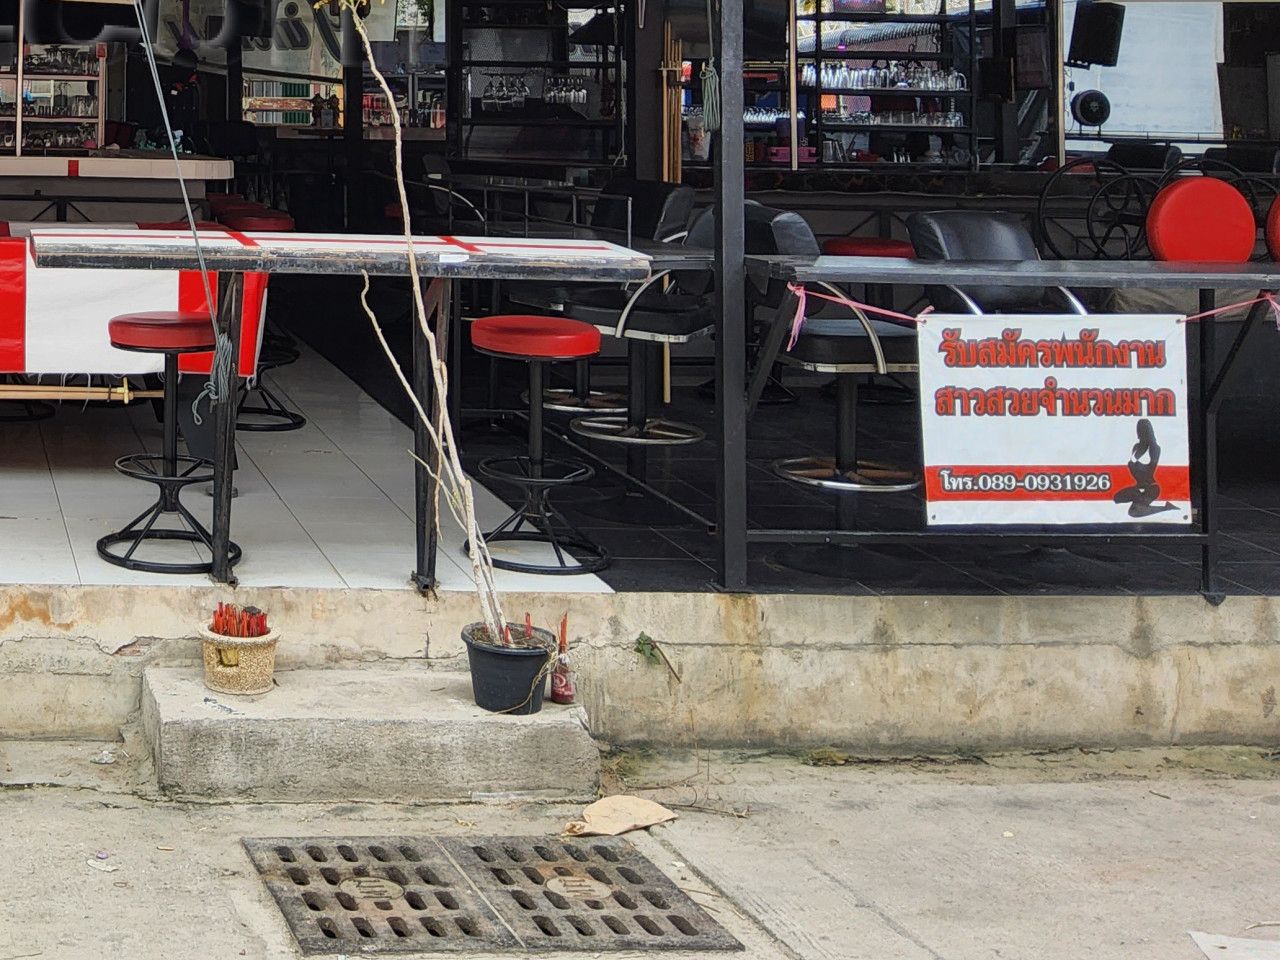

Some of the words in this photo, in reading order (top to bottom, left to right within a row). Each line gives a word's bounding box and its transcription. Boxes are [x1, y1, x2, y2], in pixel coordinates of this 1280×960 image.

[939, 328, 1167, 368] รับสมัครพนักงาน
[935, 376, 1176, 417] สาวสวยจำนวนมาก
